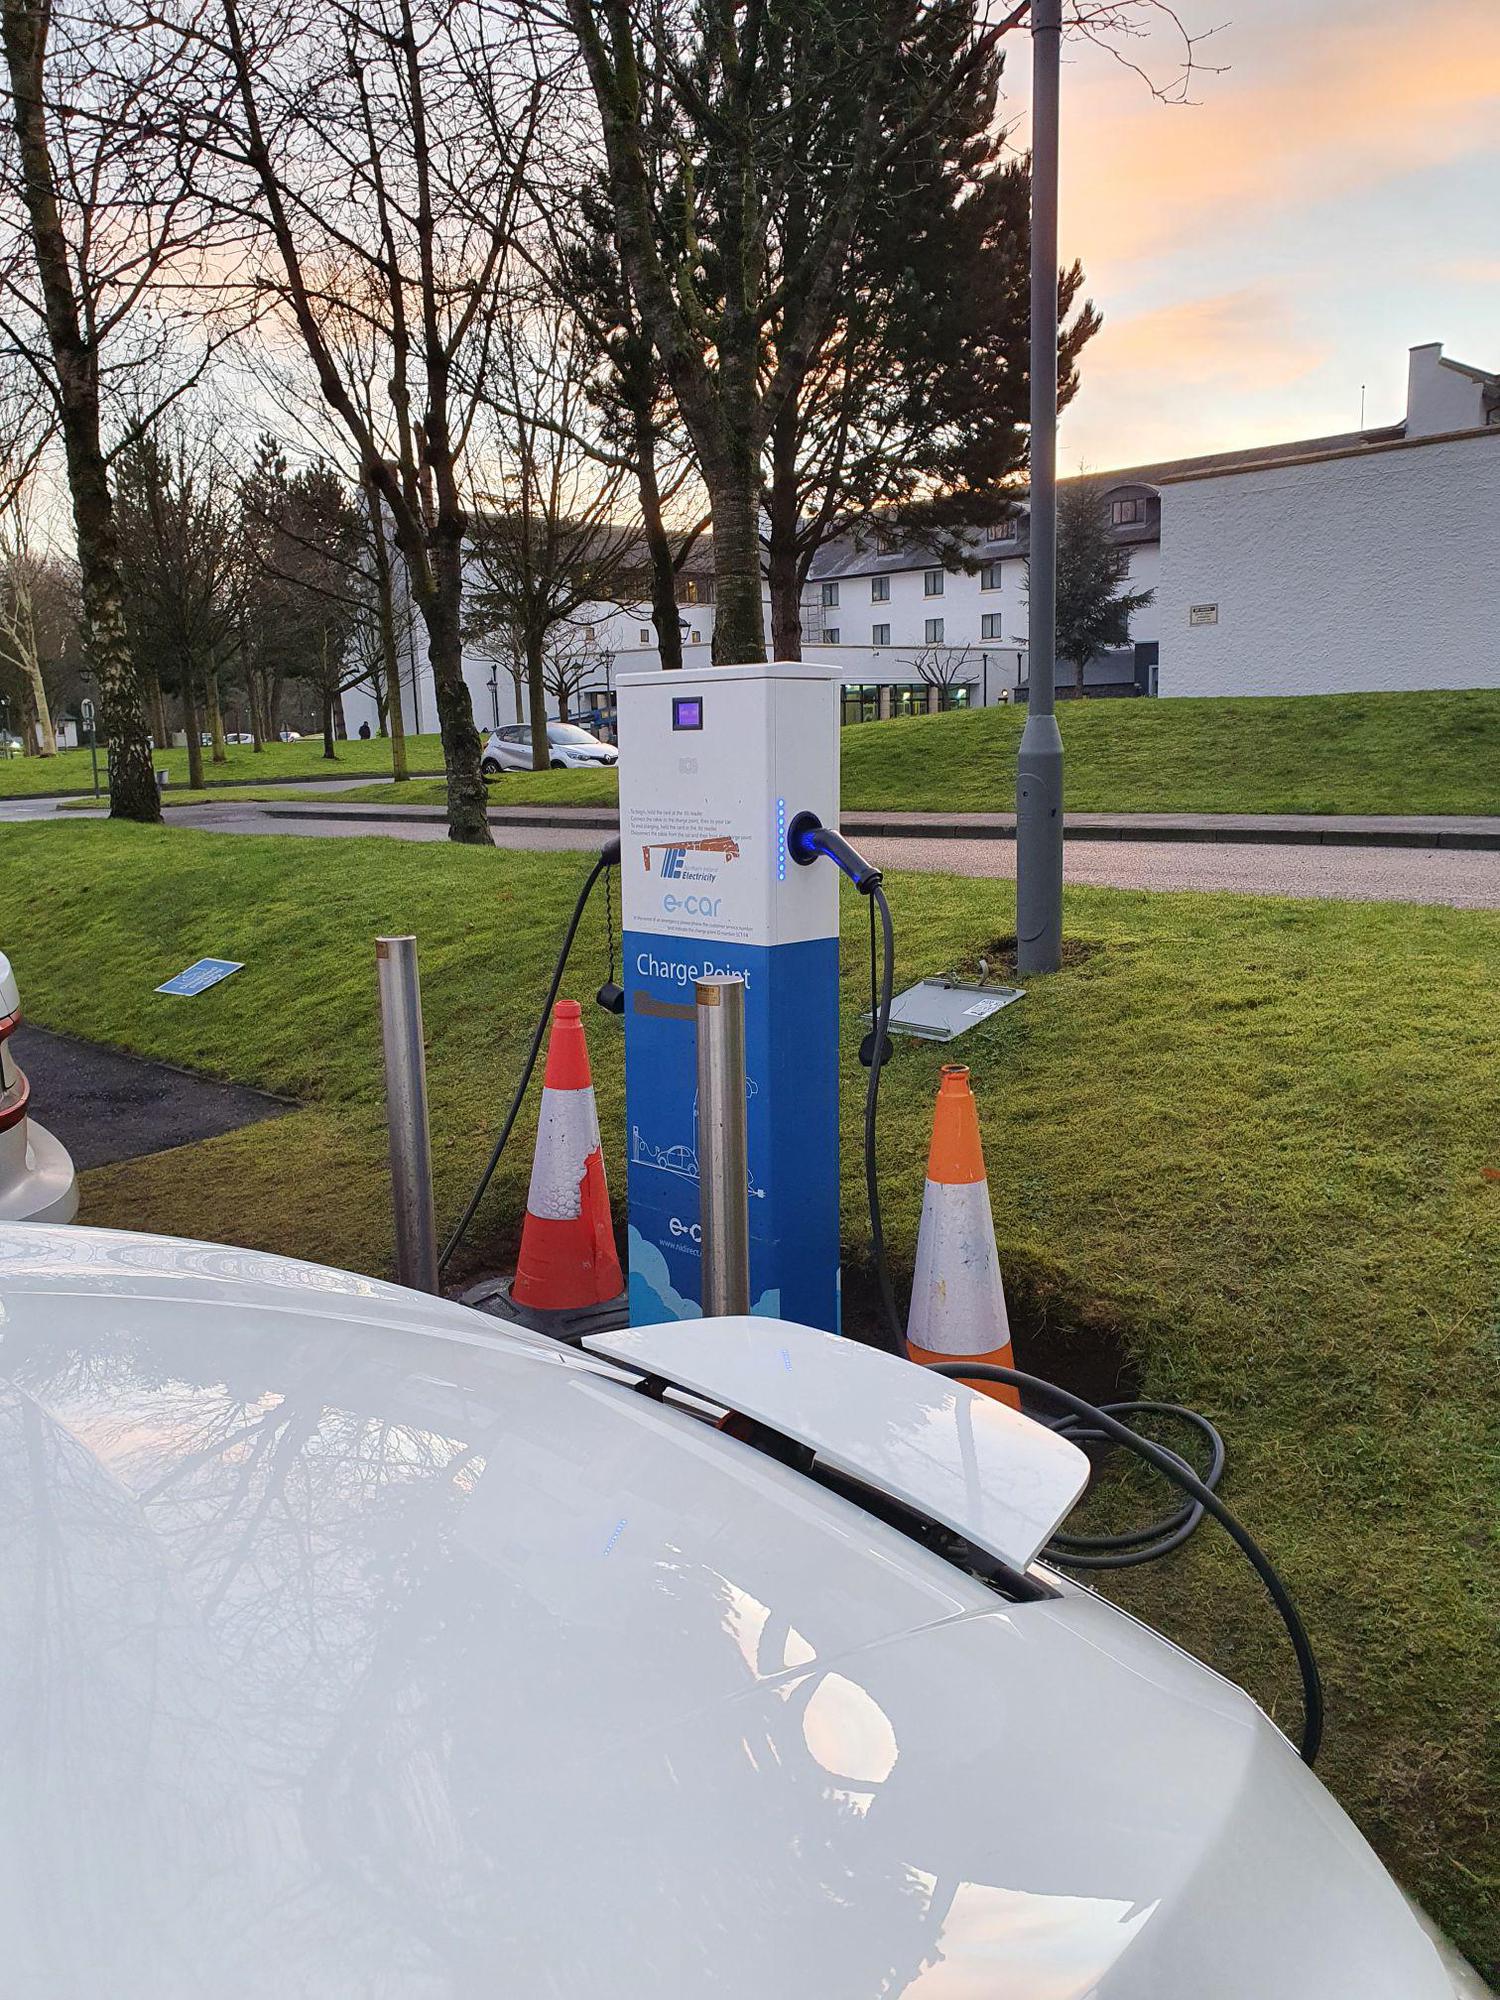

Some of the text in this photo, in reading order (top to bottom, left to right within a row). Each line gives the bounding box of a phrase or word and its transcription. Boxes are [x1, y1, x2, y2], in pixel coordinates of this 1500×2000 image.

[682, 871, 717, 883] Electricity
[663, 893, 722, 917] e-car
[636, 952, 698, 986] Charge
[669, 1217, 702, 1243] e-c
